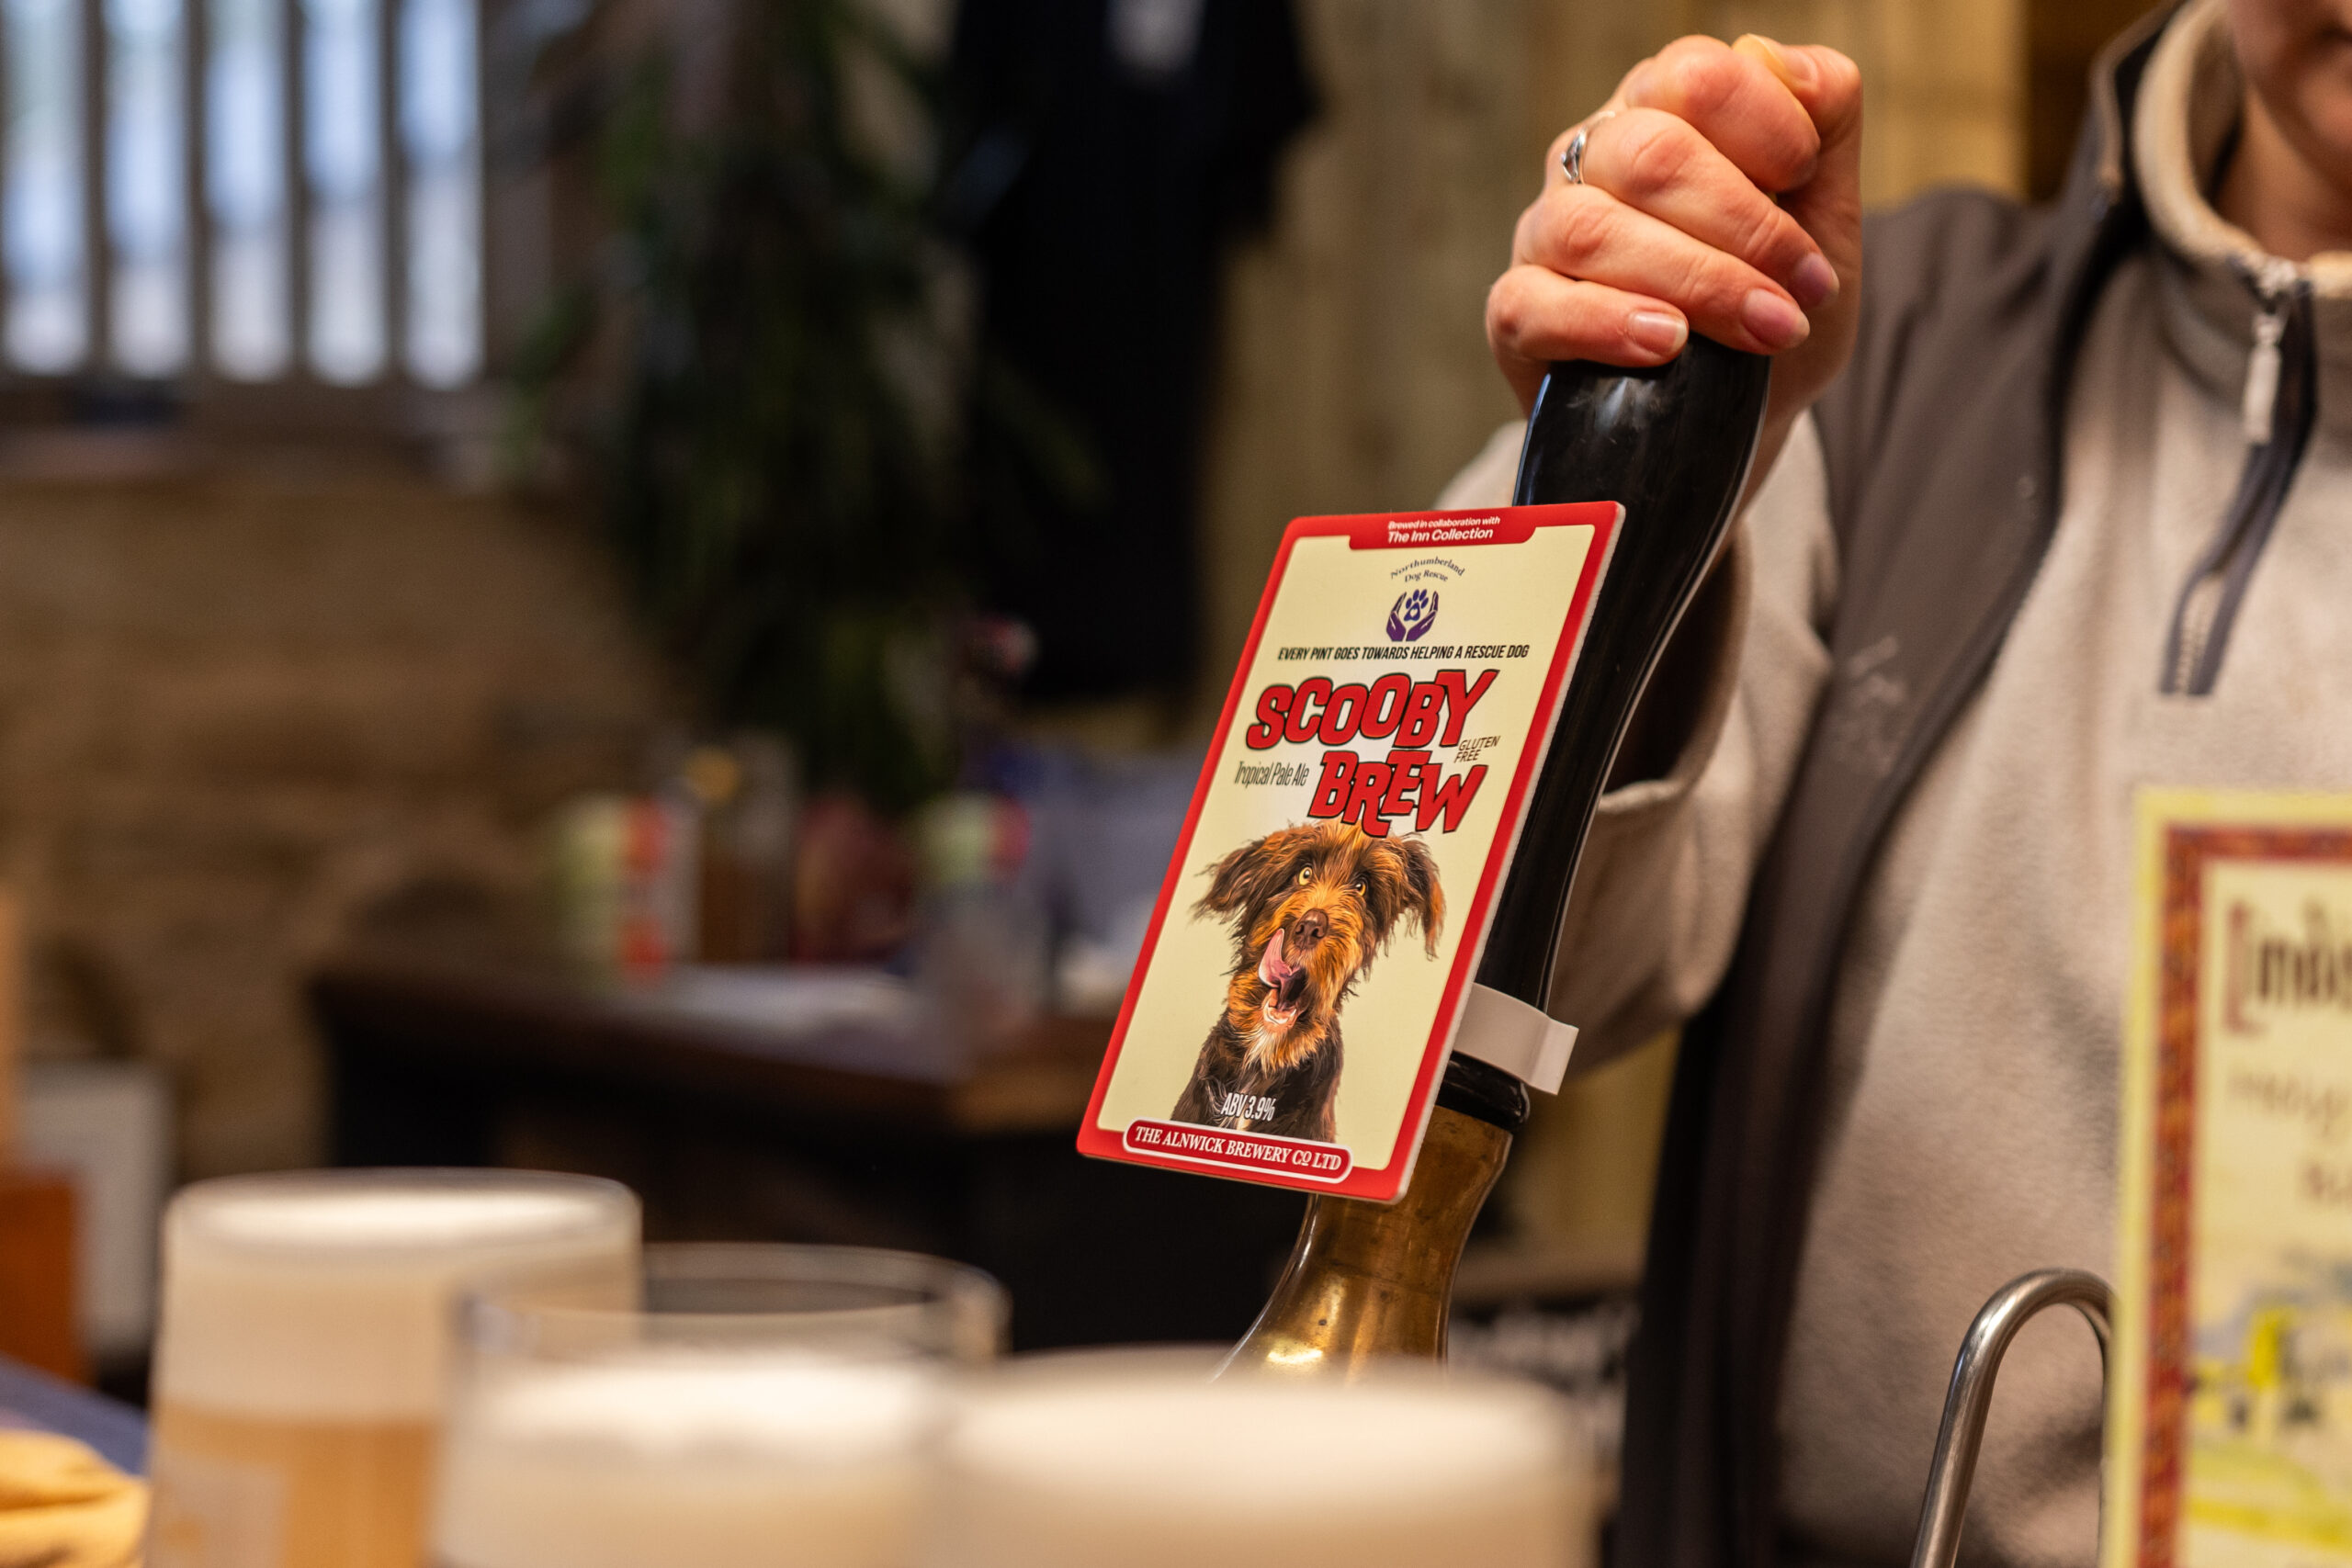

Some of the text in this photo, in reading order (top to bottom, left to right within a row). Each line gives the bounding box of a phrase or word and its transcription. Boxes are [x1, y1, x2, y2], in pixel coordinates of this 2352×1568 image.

[1388, 516, 1500, 530] Brewed in collaboration with
[1388, 527, 1494, 544] The Inn Collection
[1390, 556, 1465, 580] Northumberland
[1404, 570, 1449, 582] Dog Rescue
[1277, 644, 1531, 660] EVERY PINT GOES TOWARDS HELPING A RESCUE DOG
[1246, 669, 1500, 750] SCOOBY
[1458, 735, 1501, 751] GLUTEN
[1453, 749, 1482, 763] FREE
[1234, 760, 1311, 789] Tropical Pale Ale
[1307, 750, 1489, 838] BREW
[1220, 1092, 1277, 1122] ABV 3.9%
[1135, 1125, 1163, 1145] THE
[1161, 1131, 1227, 1154] ALNWICK
[1225, 1139, 1293, 1164] BREWERY
[1311, 1152, 1342, 1171] LTD
